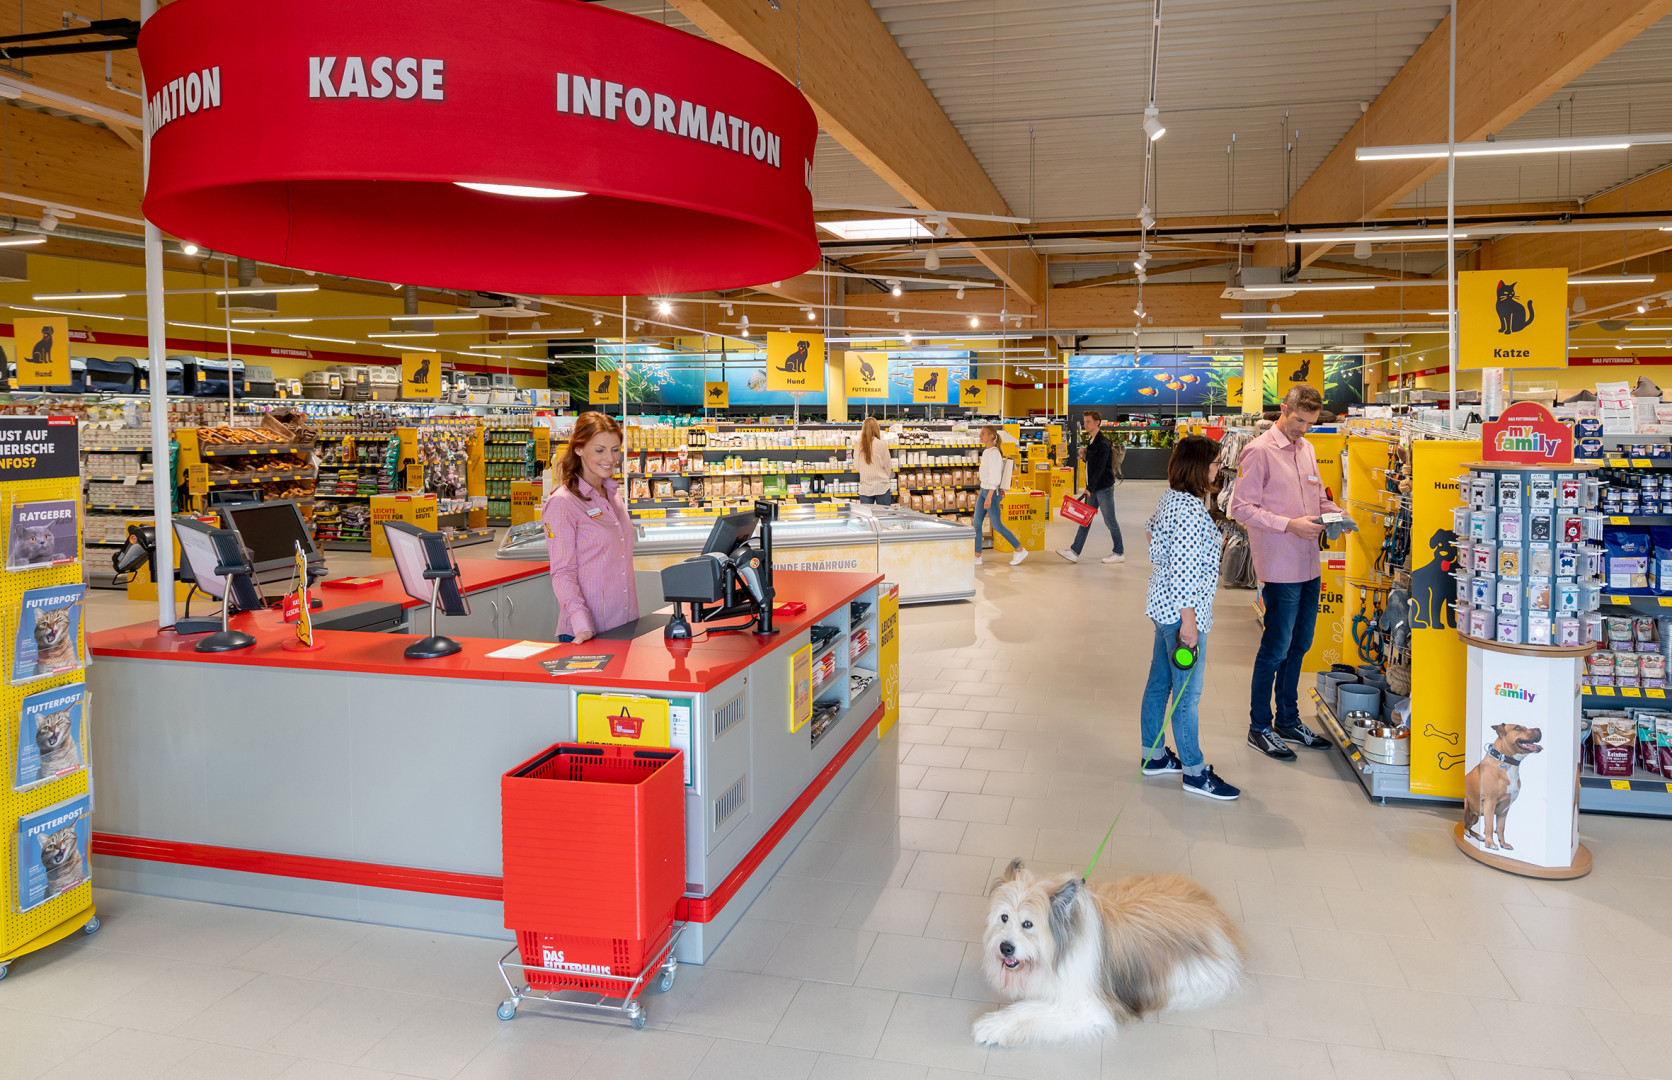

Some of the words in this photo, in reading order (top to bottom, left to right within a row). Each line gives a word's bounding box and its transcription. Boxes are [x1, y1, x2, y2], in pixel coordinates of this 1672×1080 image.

[309, 56, 444, 100] KASSE
[556, 72, 781, 168] INFORMATION
[1494, 348, 1530, 358] Katze
[25, 430, 48, 440] AUF
[1509, 426, 1533, 438] my
[1495, 431, 1559, 457] family
[19, 509, 72, 521] RATGEBER
[801, 559, 857, 571] ERNÄHRUNG
[26, 593, 82, 609] FUTTERPOST
[1320, 592, 1343, 603] FÜR
[1503, 682, 1519, 690] my
[1494, 684, 1535, 703] family
[26, 693, 81, 715] FUTTERPOST
[28, 807, 84, 837] FUTTERPOST
[542, 950, 565, 962] DAS
